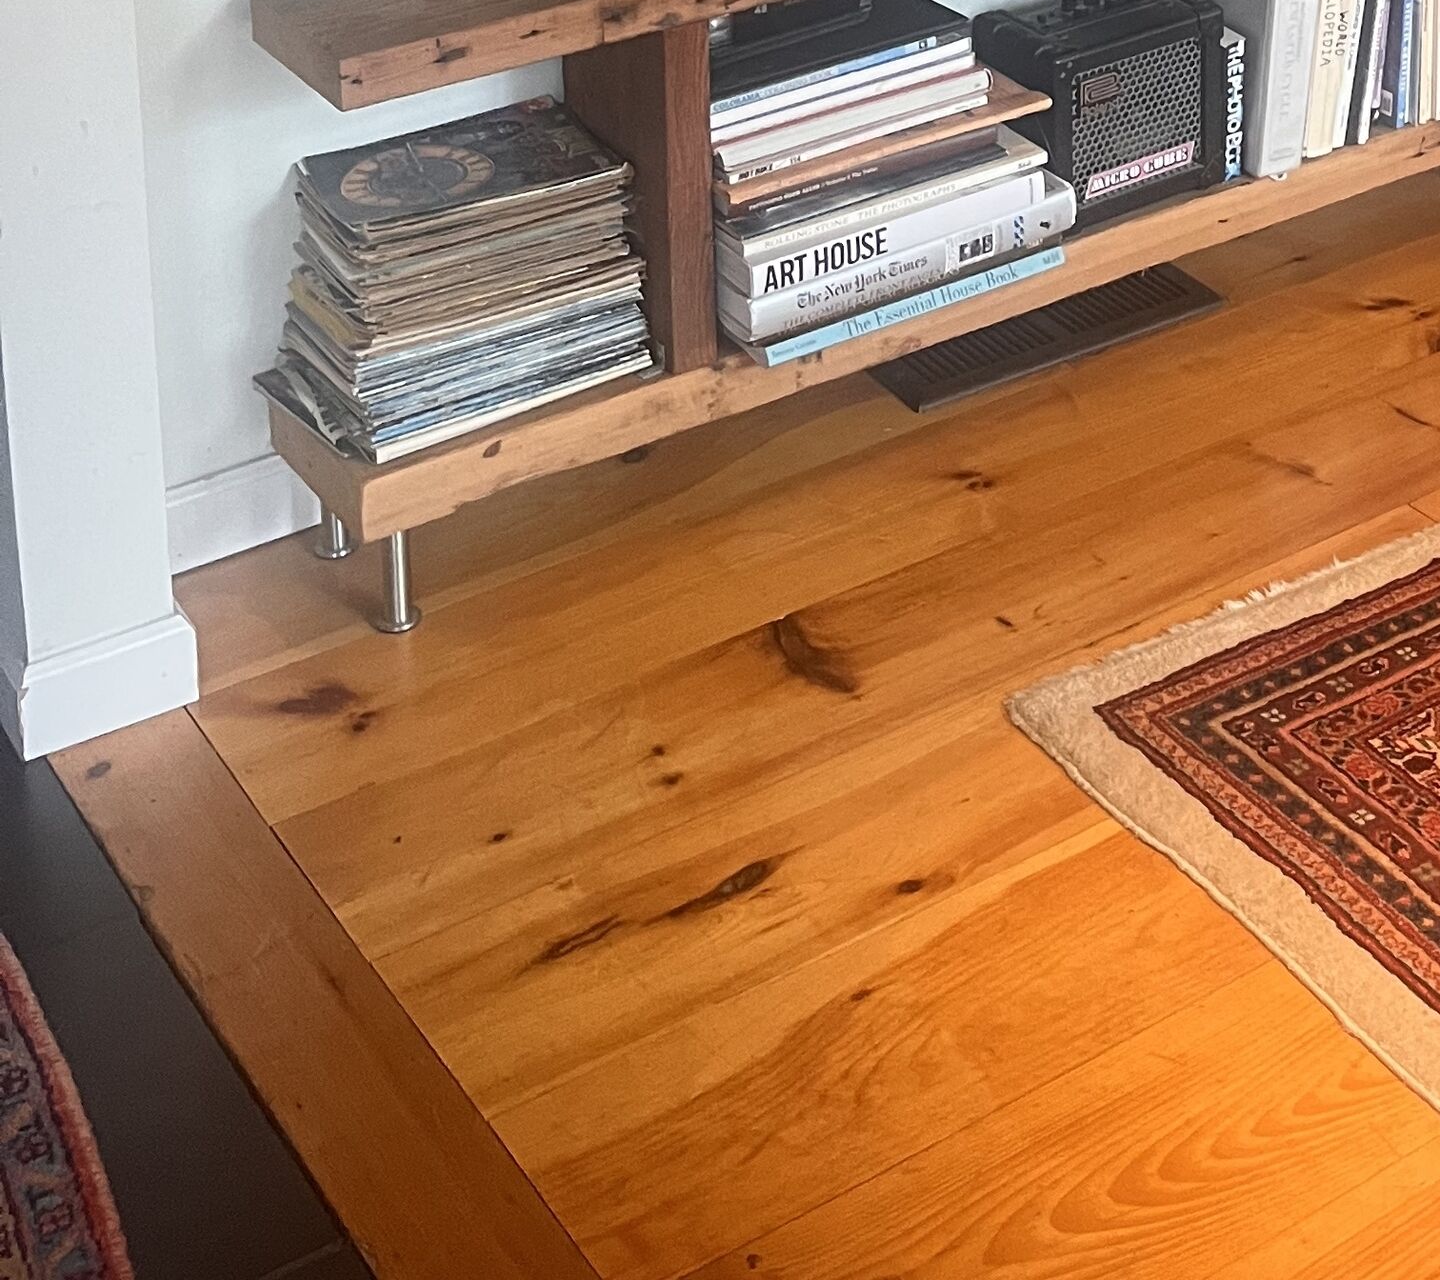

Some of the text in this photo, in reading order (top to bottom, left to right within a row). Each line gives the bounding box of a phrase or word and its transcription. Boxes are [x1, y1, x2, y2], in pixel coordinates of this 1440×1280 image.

[1334, 11, 1349, 57] WORLD
[1091, 147, 1190, 192] MICRO CUBE
[857, 206, 879, 220] THE
[881, 183, 957, 214] PHOTOGRAPHS
[764, 226, 889, 294] ART HOUSE
[796, 255, 929, 309] The New York Times
[842, 262, 1021, 339] The Essential House Book
